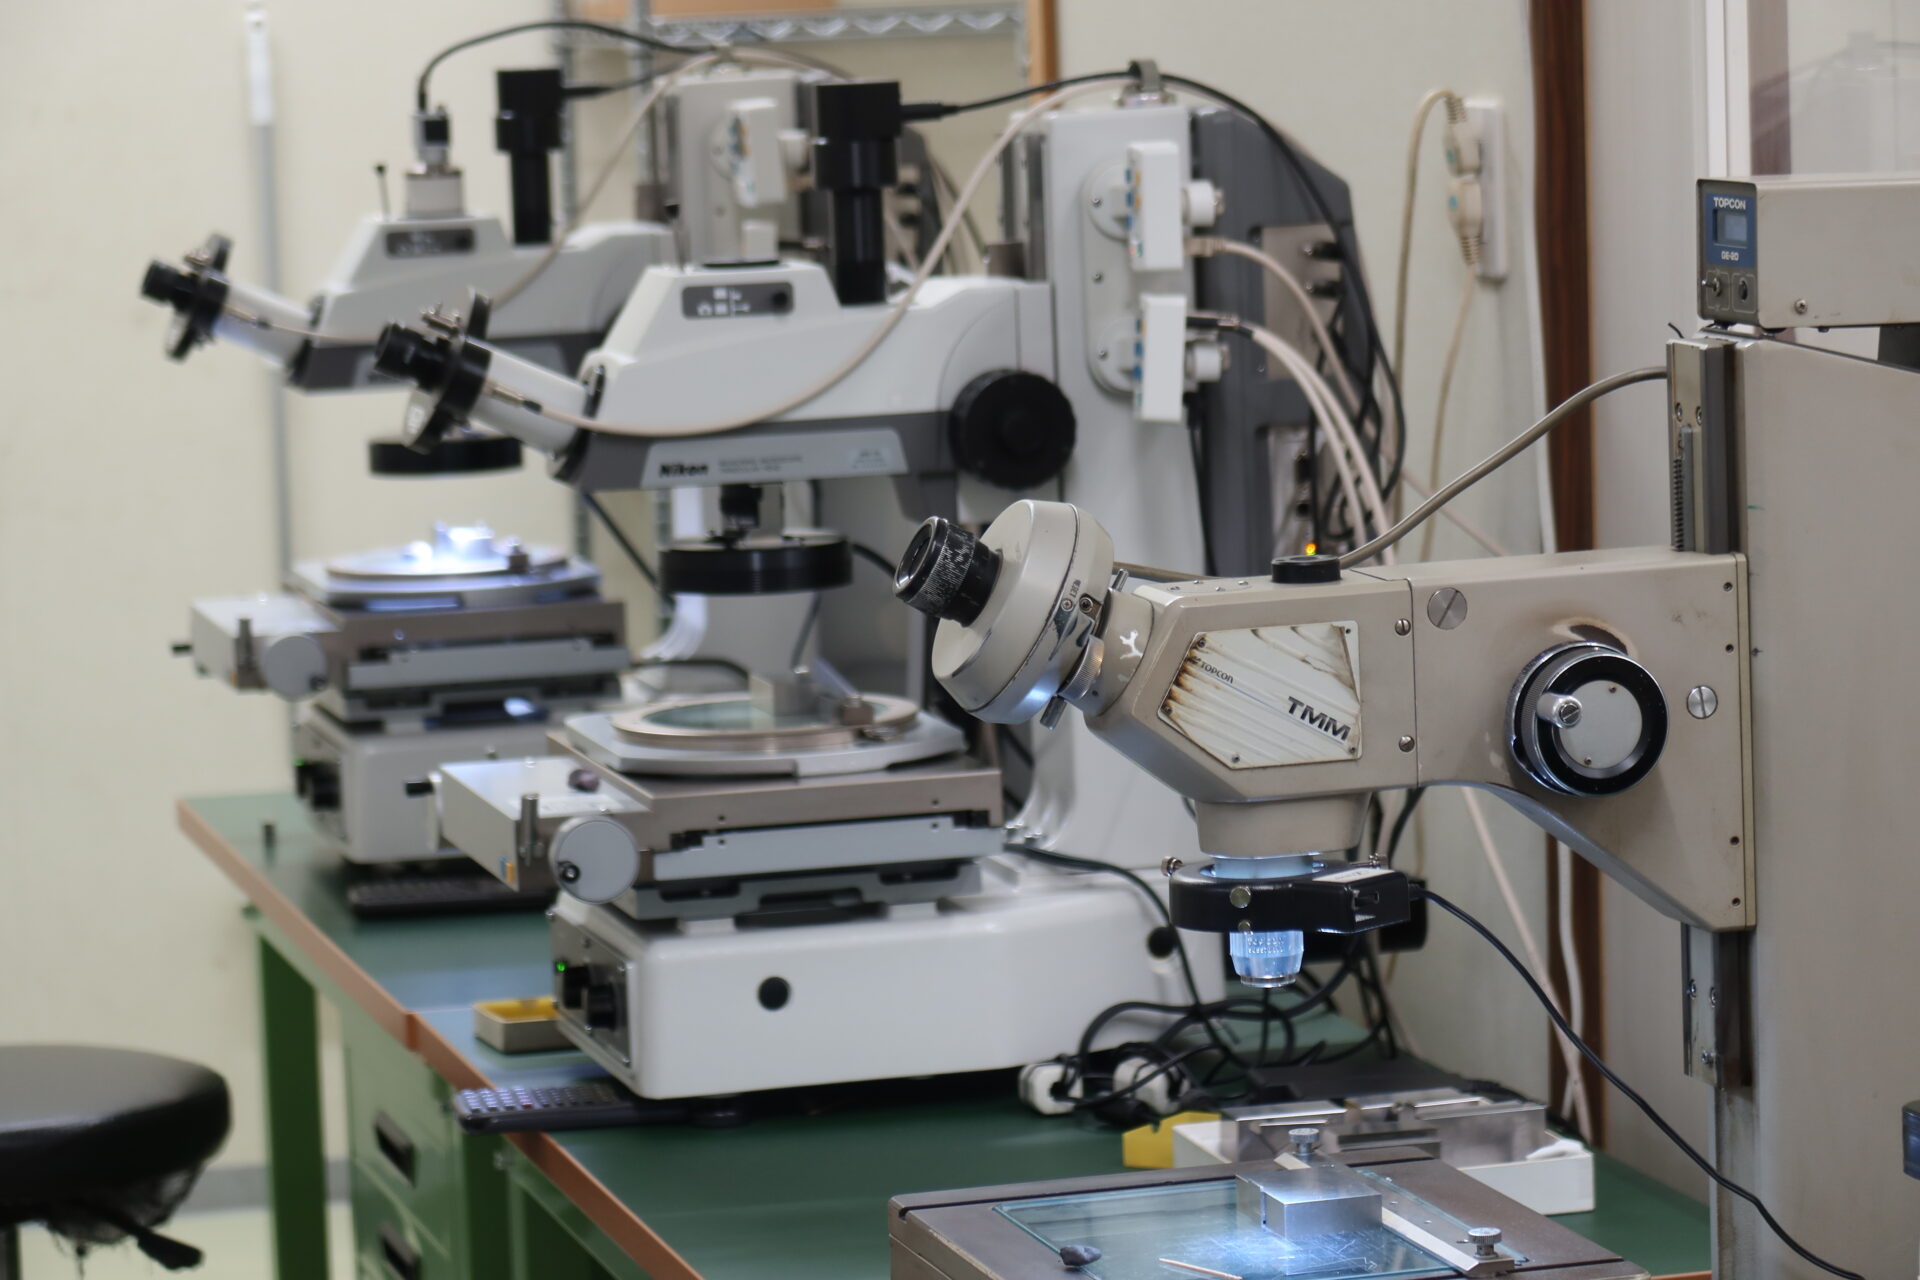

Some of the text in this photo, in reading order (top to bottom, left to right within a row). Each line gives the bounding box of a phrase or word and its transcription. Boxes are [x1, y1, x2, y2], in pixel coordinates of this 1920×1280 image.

[1713, 197, 1746, 210] TOPCON
[658, 463, 708, 478] Nikon
[1288, 695, 1351, 741] TMM
